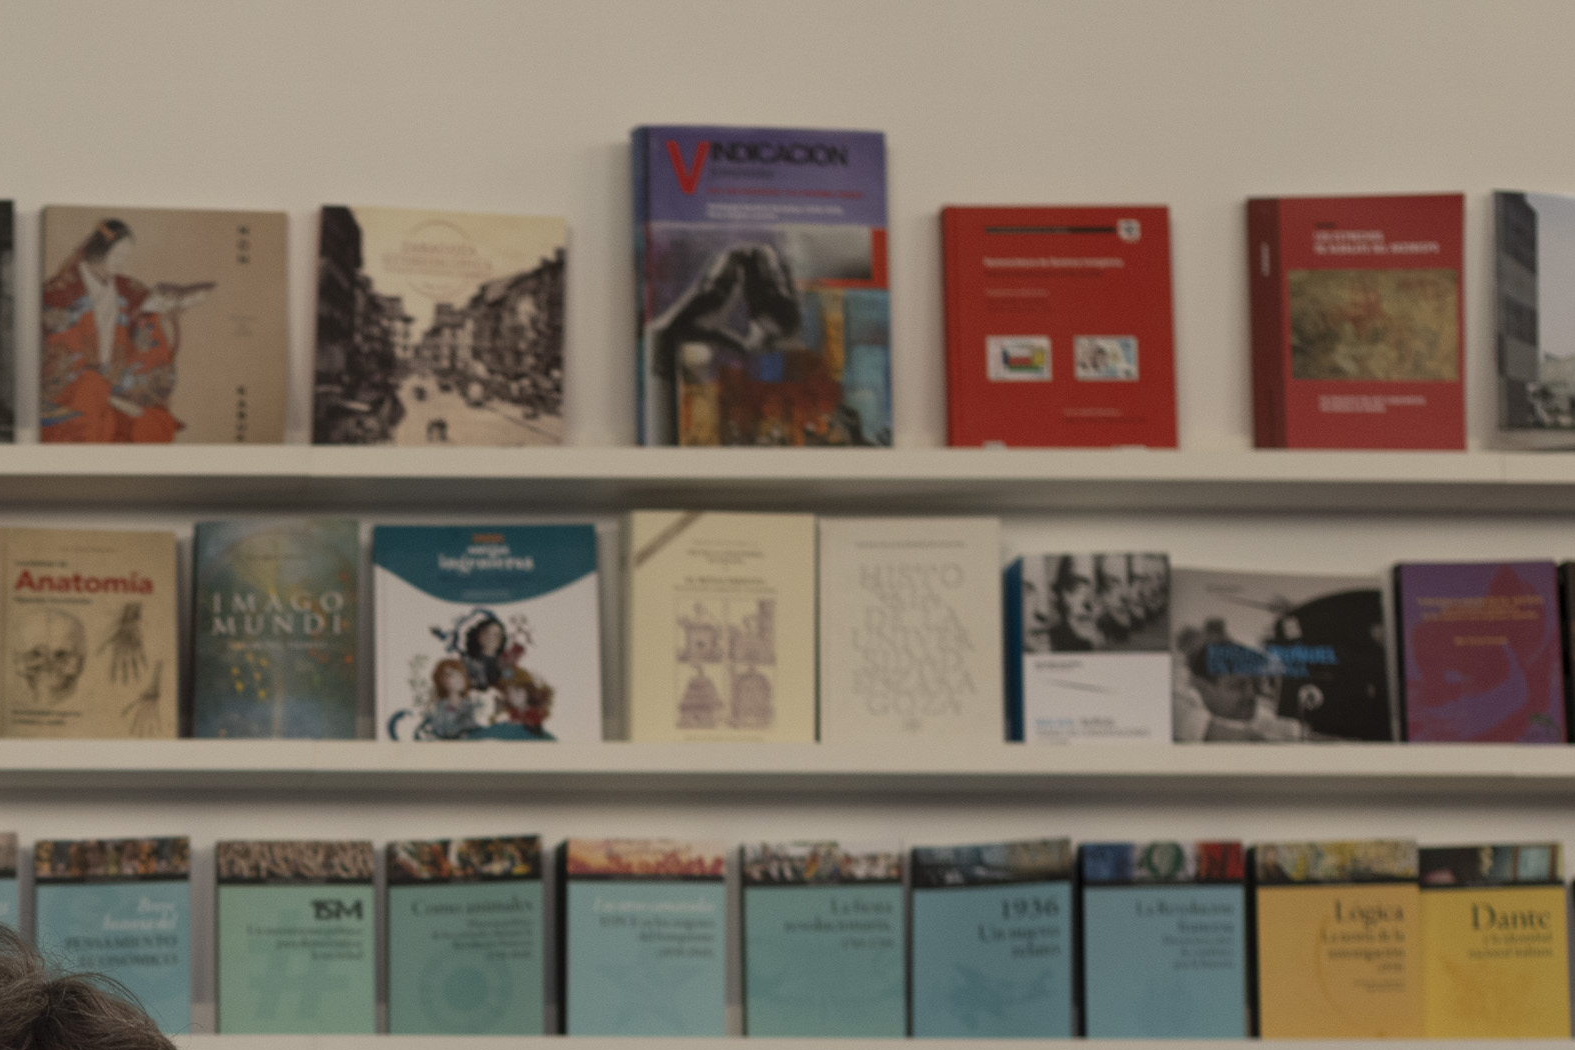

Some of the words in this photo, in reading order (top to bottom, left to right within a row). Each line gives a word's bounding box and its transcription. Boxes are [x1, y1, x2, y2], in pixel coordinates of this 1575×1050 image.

[14, 570, 154, 596] Anatomía
[212, 590, 345, 613] IMAGO
[210, 614, 343, 637] MUNDI
[1001, 899, 1061, 920] 1936
[1333, 899, 1404, 928] Lógica
[1471, 902, 1551, 931] Dante
